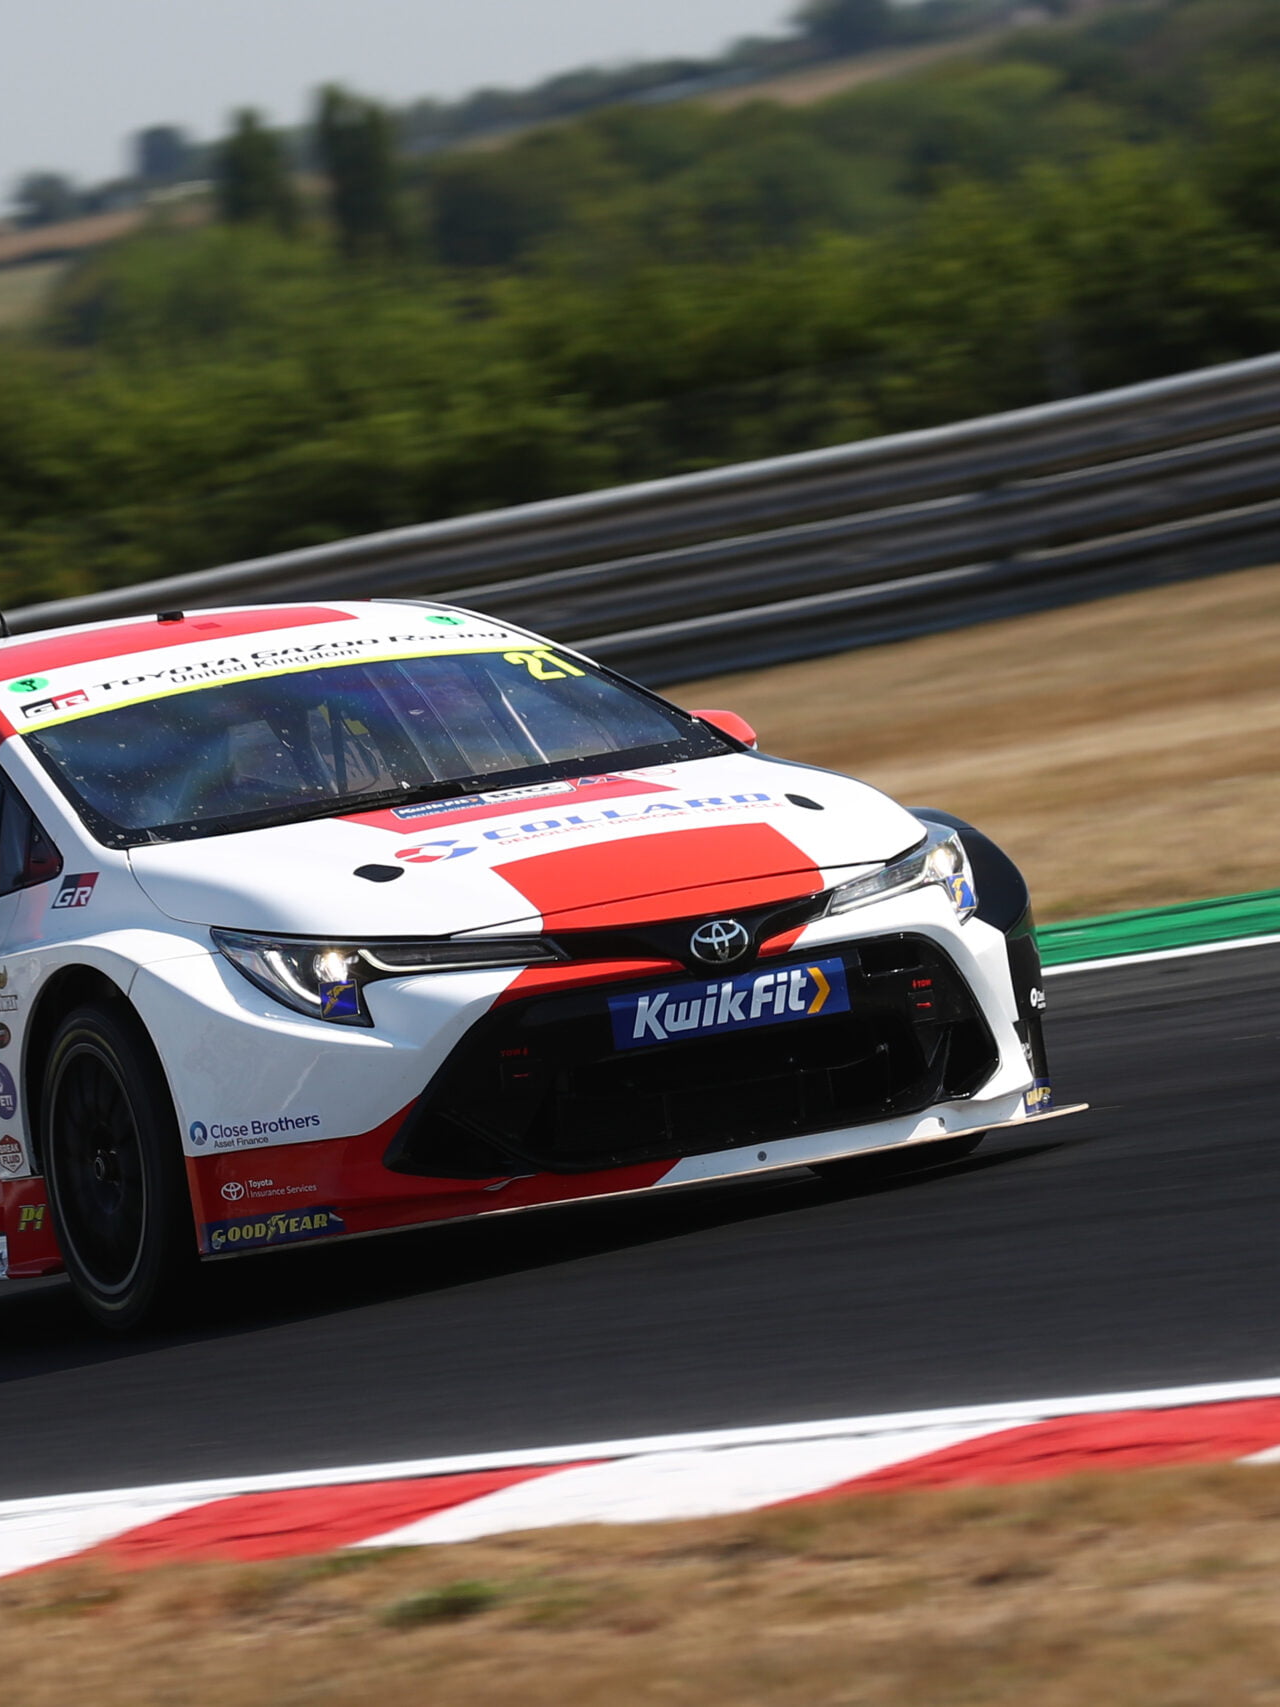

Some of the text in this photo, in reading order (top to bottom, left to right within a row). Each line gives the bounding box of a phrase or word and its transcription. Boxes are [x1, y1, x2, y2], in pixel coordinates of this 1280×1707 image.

[93, 631, 508, 691] TOYOTA GAZOO Racing
[170, 648, 360, 684] United Kingdom
[502, 650, 586, 681] 21
[21, 688, 90, 719] GR
[482, 792, 771, 840] COLLARD
[497, 803, 786, 845] DEMOLISH DISPOSE RECYCLE
[53, 885, 92, 908] GR
[210, 1115, 320, 1139] Close Brothers
[214, 1136, 269, 1149] Asset Finance
[1, 1154, 20, 1165] FLUID
[248, 1179, 273, 1188] Toyota
[250, 1184, 317, 1198] Insurance Services
[211, 1213, 328, 1243] GOODYEAR
